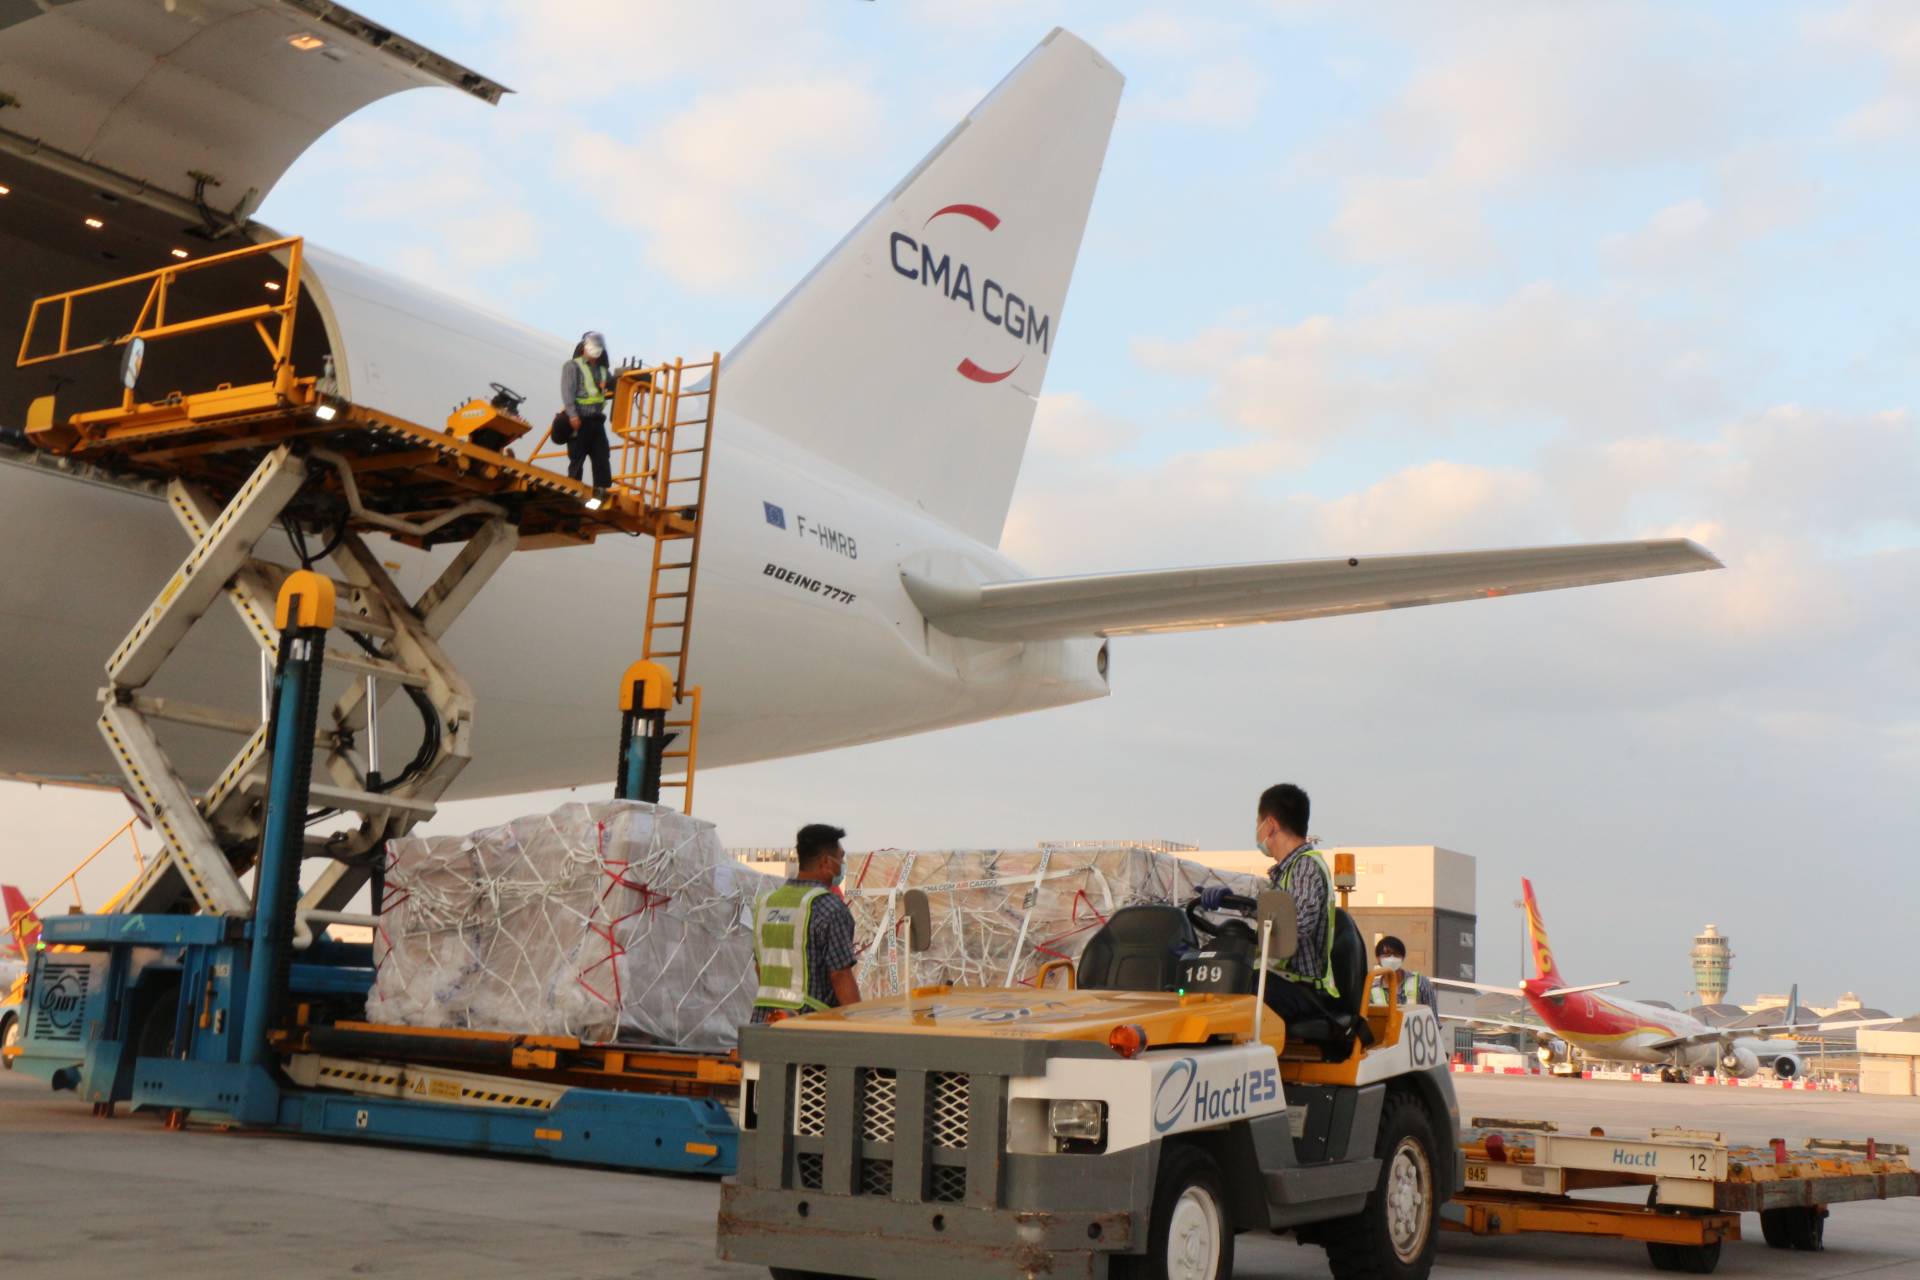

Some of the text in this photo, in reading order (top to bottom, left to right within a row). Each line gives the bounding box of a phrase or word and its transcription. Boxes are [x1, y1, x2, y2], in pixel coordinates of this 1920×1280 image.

[890, 231, 1049, 354] CMA CGM
[797, 515, 857, 559] F-HMRB
[763, 563, 856, 604] BOEING 777F
[970, 879, 998, 888] CARGO
[890, 964, 898, 993] CARGO
[1186, 964, 1222, 982] 189
[1404, 1014, 1438, 1068] 189
[1193, 1068, 1277, 1123] Hactl 25
[1613, 1148, 1657, 1167] Hactl
[1689, 1153, 1707, 1172] 12
[1467, 1167, 1487, 1182] 945
